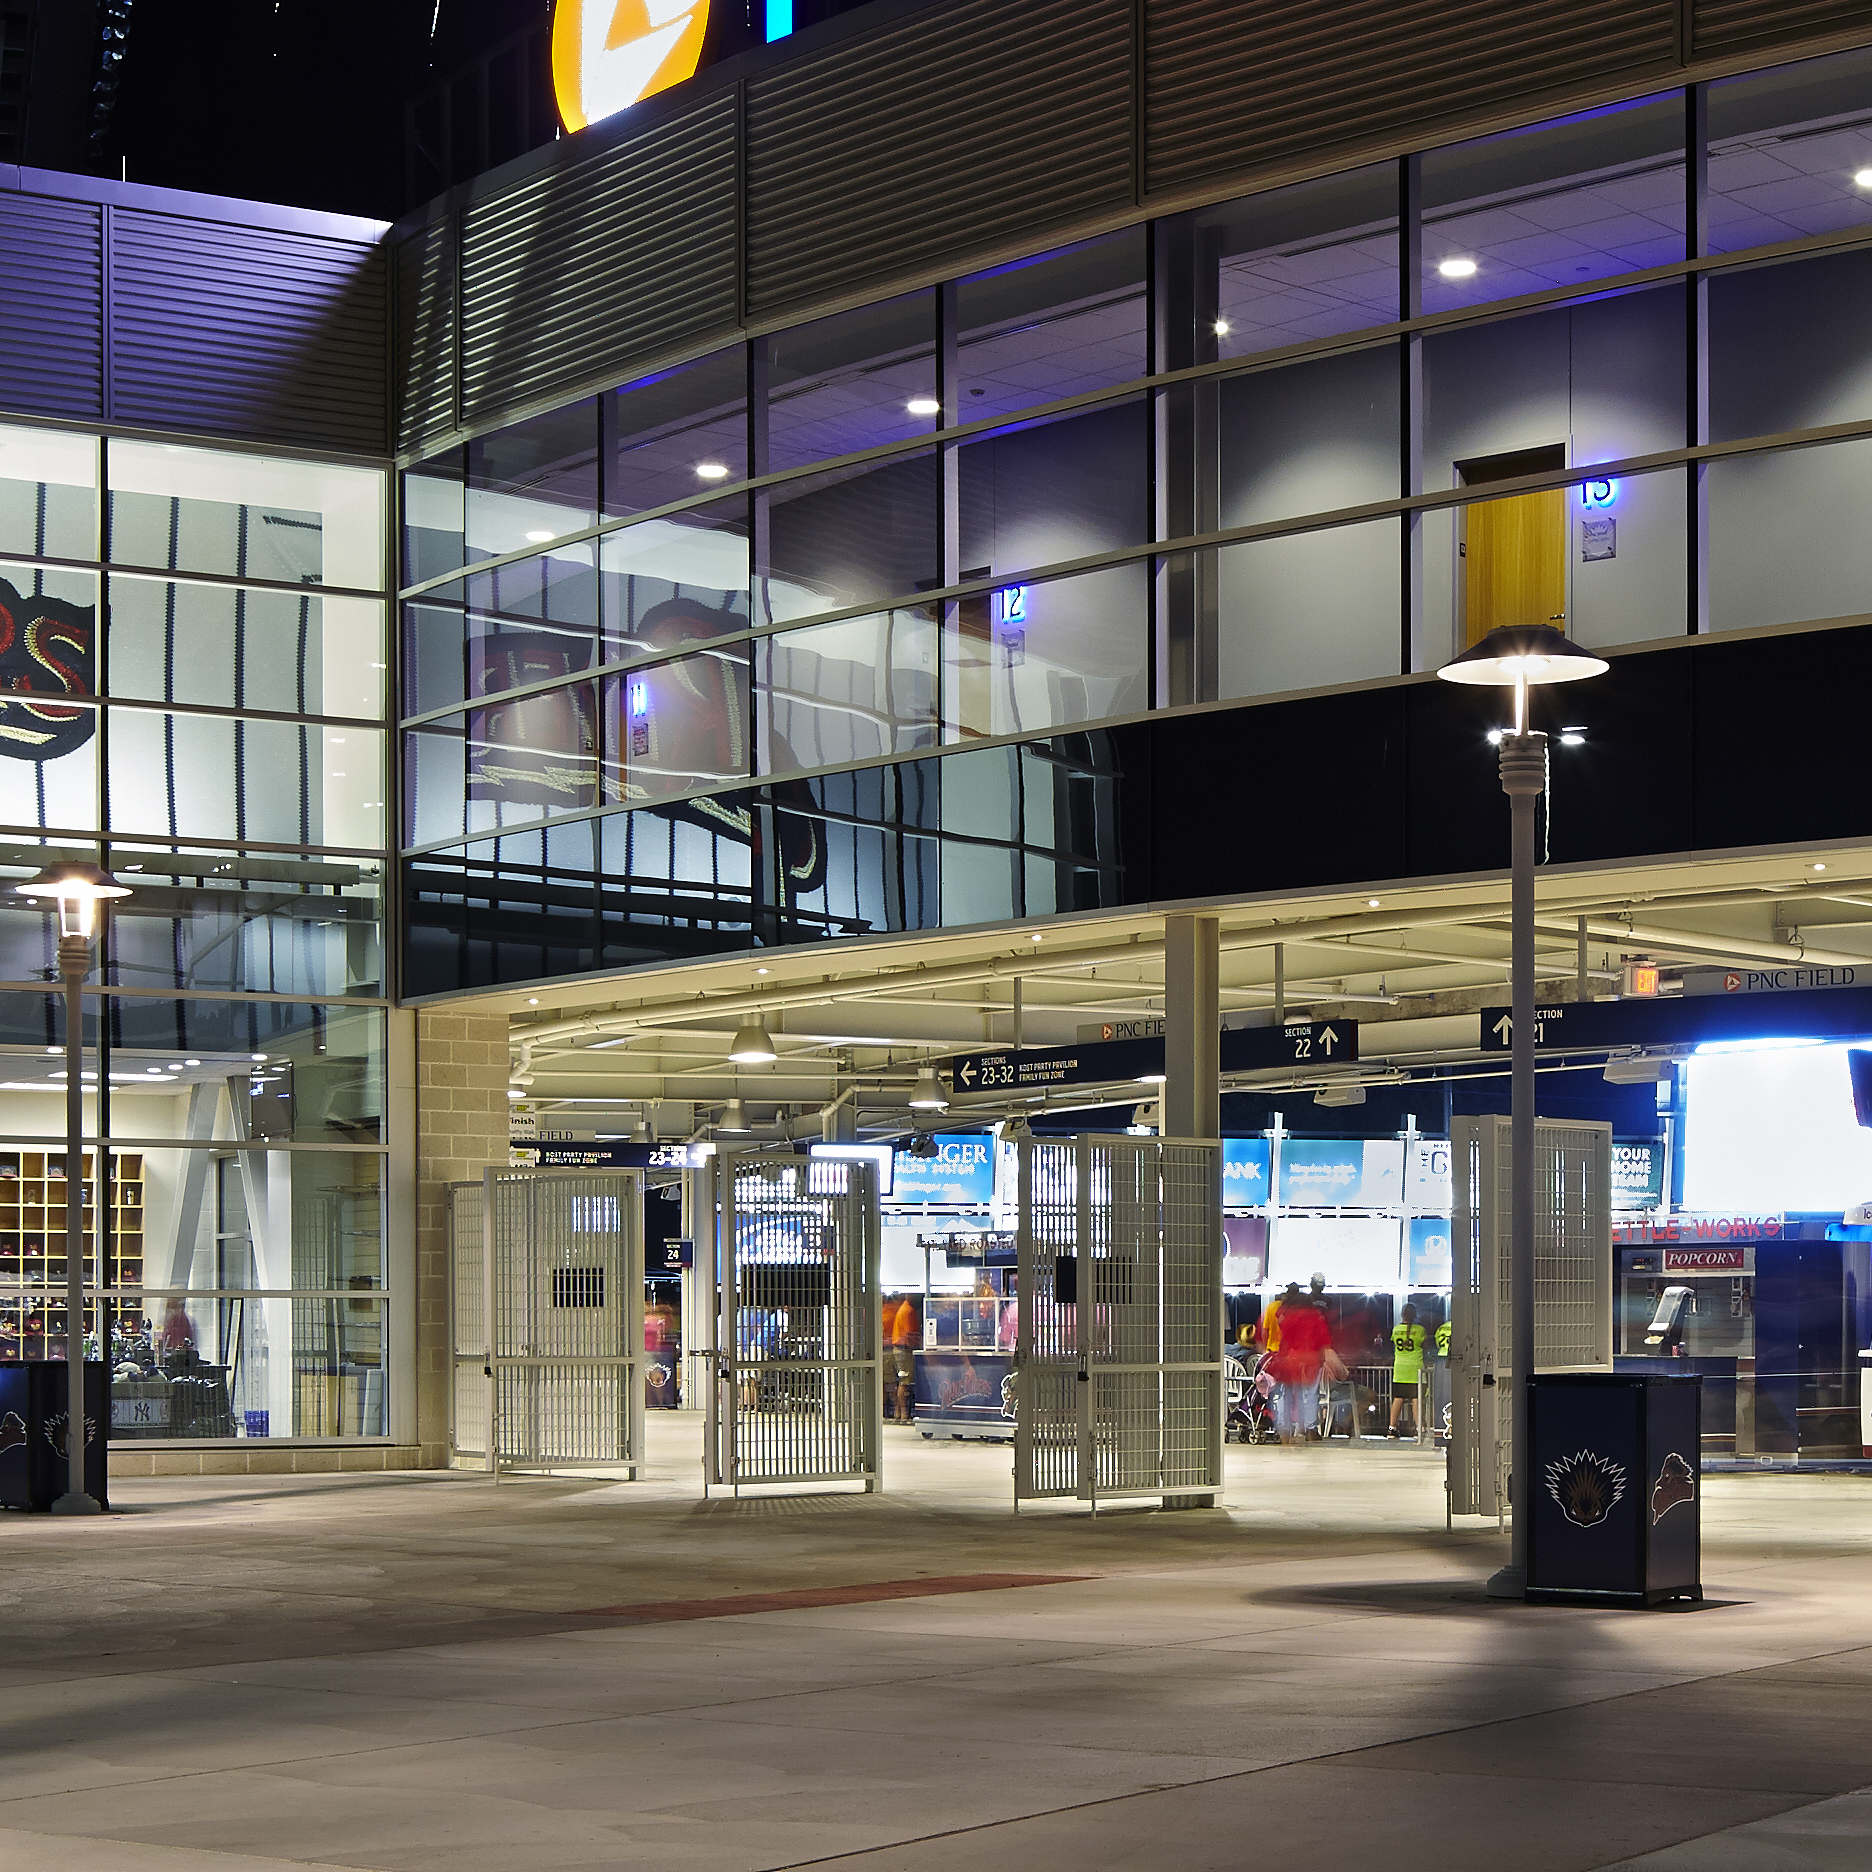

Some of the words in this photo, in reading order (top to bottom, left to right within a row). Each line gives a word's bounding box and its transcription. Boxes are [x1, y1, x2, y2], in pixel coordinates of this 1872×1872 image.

[1746, 971, 1788, 990] PNC
[1794, 967, 1855, 987] FIELD
[1534, 1009, 1564, 1020] ECTION
[1115, 1021, 1144, 1039] PNC
[1145, 1019, 1166, 1036] FIE
[1284, 1026, 1312, 1037] SECTION
[1295, 1038, 1312, 1058] 22
[981, 1056, 1006, 1066] SECTIONS
[1034, 1062, 1052, 1071] PARTY
[981, 1066, 1014, 1085] 23-32
[538, 1130, 574, 1141] FIELD
[1612, 1147, 1651, 1161] YOUR
[1612, 1216, 1782, 1242] ETTLE-WORKS
[667, 1249, 679, 1260] 24
[1668, 1251, 1737, 1266] POPCORN
